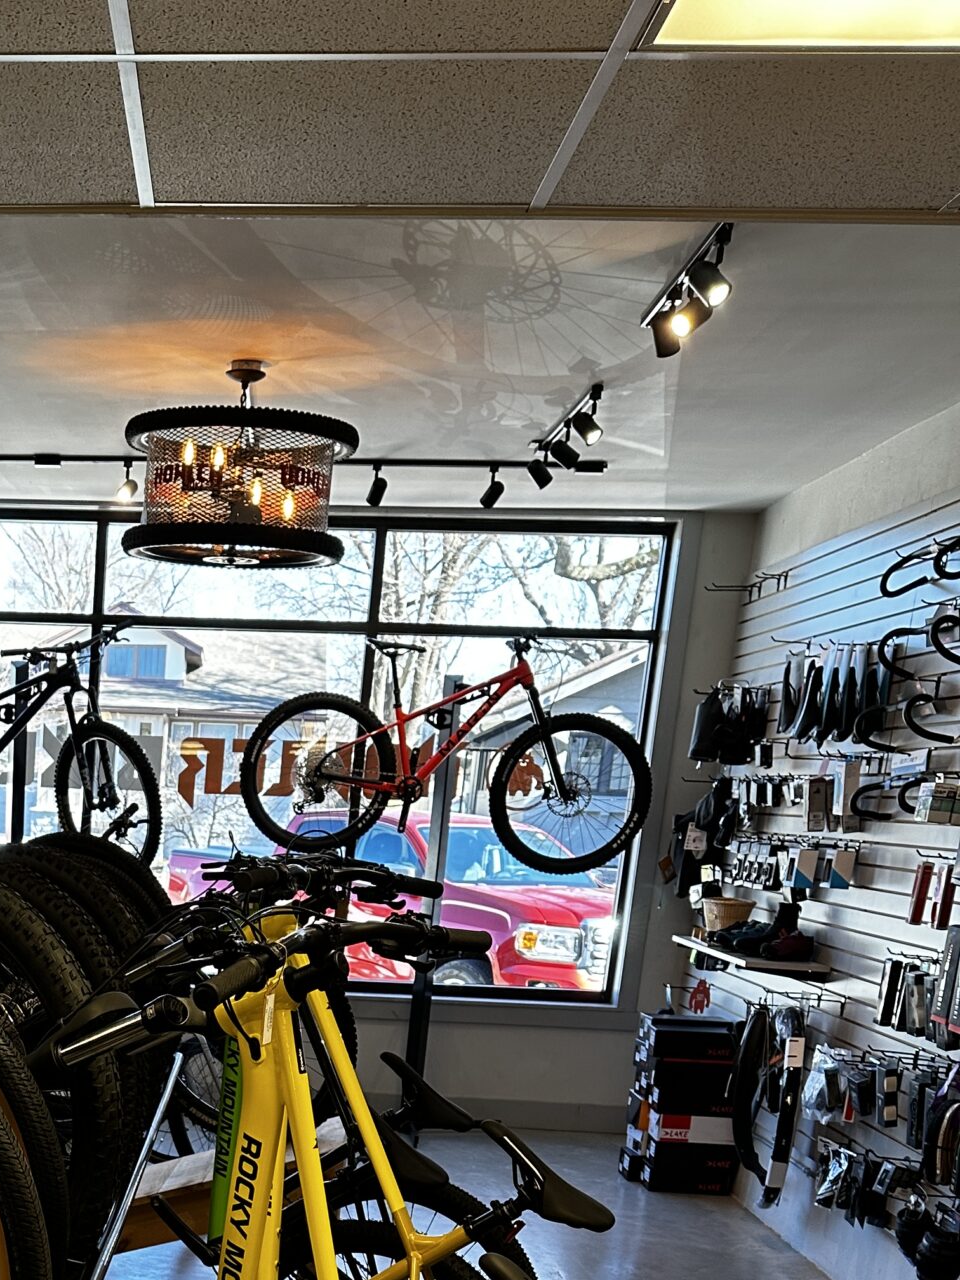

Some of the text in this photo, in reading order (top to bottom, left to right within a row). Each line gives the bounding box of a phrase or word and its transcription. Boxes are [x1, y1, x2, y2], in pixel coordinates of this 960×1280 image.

[438, 690, 501, 757] MARIN
[612, 812, 638, 848] MAXXIS
[214, 1035, 240, 1179] CKY MOUNTAIN
[229, 1131, 263, 1241] ROCKY
